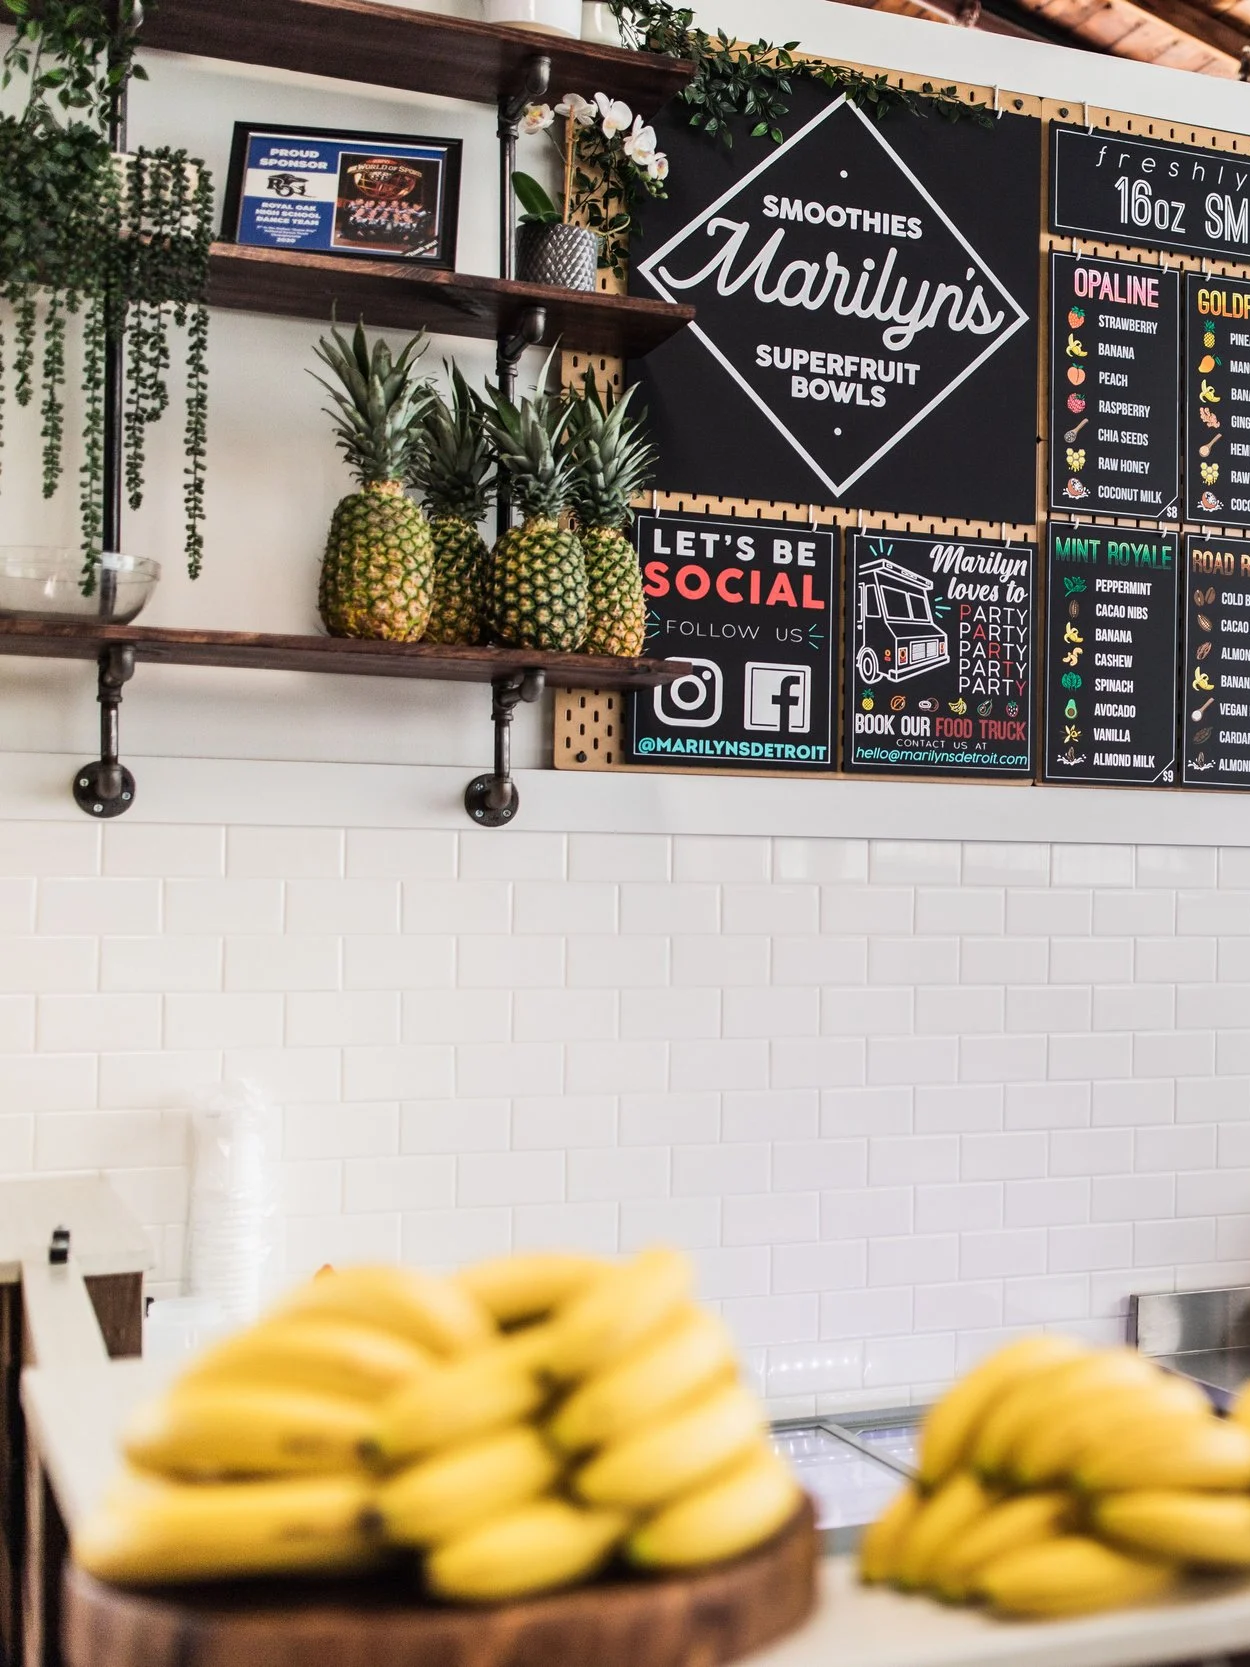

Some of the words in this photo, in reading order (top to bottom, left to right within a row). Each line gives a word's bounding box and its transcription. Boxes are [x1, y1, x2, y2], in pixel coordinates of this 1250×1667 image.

[270, 148, 319, 158] PROUD
[259, 158, 328, 169] SPONSOR
[1096, 146, 1248, 192] freshly
[281, 211, 321, 219] SCHOOL
[762, 195, 923, 239] SMOOTHIES
[658, 217, 1004, 351] Marilyn's
[1074, 268, 1159, 308] OPALINE
[1098, 315, 1158, 335] STRAWBERRY
[1098, 343, 1135, 360] BANANA
[755, 344, 920, 385] SUPERFRUIT
[1099, 372, 1128, 387] PEACH
[791, 376, 886, 408] BOWLS
[1099, 401, 1150, 419] RASPBERRY
[1098, 457, 1119, 472] RAW
[1121, 459, 1150, 474] HONEY
[1098, 485, 1138, 502] COCONUT
[1140, 489, 1162, 504] MILK
[1167, 505, 1178, 518] $8
[653, 528, 755, 561] LET'S
[773, 539, 816, 567] BE
[1055, 536, 1101, 564] MINT
[1107, 541, 1173, 570] ROYALE
[930, 544, 1027, 583] Marilyn
[1192, 549, 1235, 577] ROAD
[643, 561, 825, 609] SOCIAL
[948, 577, 999, 601] loves
[1006, 581, 1028, 603] to
[1096, 579, 1152, 596] PEPPERMINT
[960, 605, 1027, 625] PARTY
[1096, 604, 1126, 618] CACAO
[1127, 606, 1149, 620] NIBS
[666, 619, 760, 640] FOLLOW
[776, 628, 803, 642] US
[959, 622, 1027, 644] PARTY
[959, 641, 1027, 661] PARTY
[959, 659, 1027, 679] PARTY
[959, 677, 1026, 696] PARTY
[1095, 678, 1134, 693] SPINACH
[855, 713, 895, 736] BOOK
[901, 715, 930, 737] OUR
[935, 717, 972, 739] FOOD
[979, 719, 1026, 741] TRUCK
[638, 737, 827, 760] @MARILYNSDETROIT
[896, 739, 945, 748] CONTACT
[954, 741, 968, 750] US
[975, 742, 987, 750] AT
[855, 747, 1027, 765] hello@marilynsdetroit.com
[1093, 752, 1131, 767] ALMOND
[1133, 755, 1155, 769] MILK
[1163, 770, 1173, 783] $9
